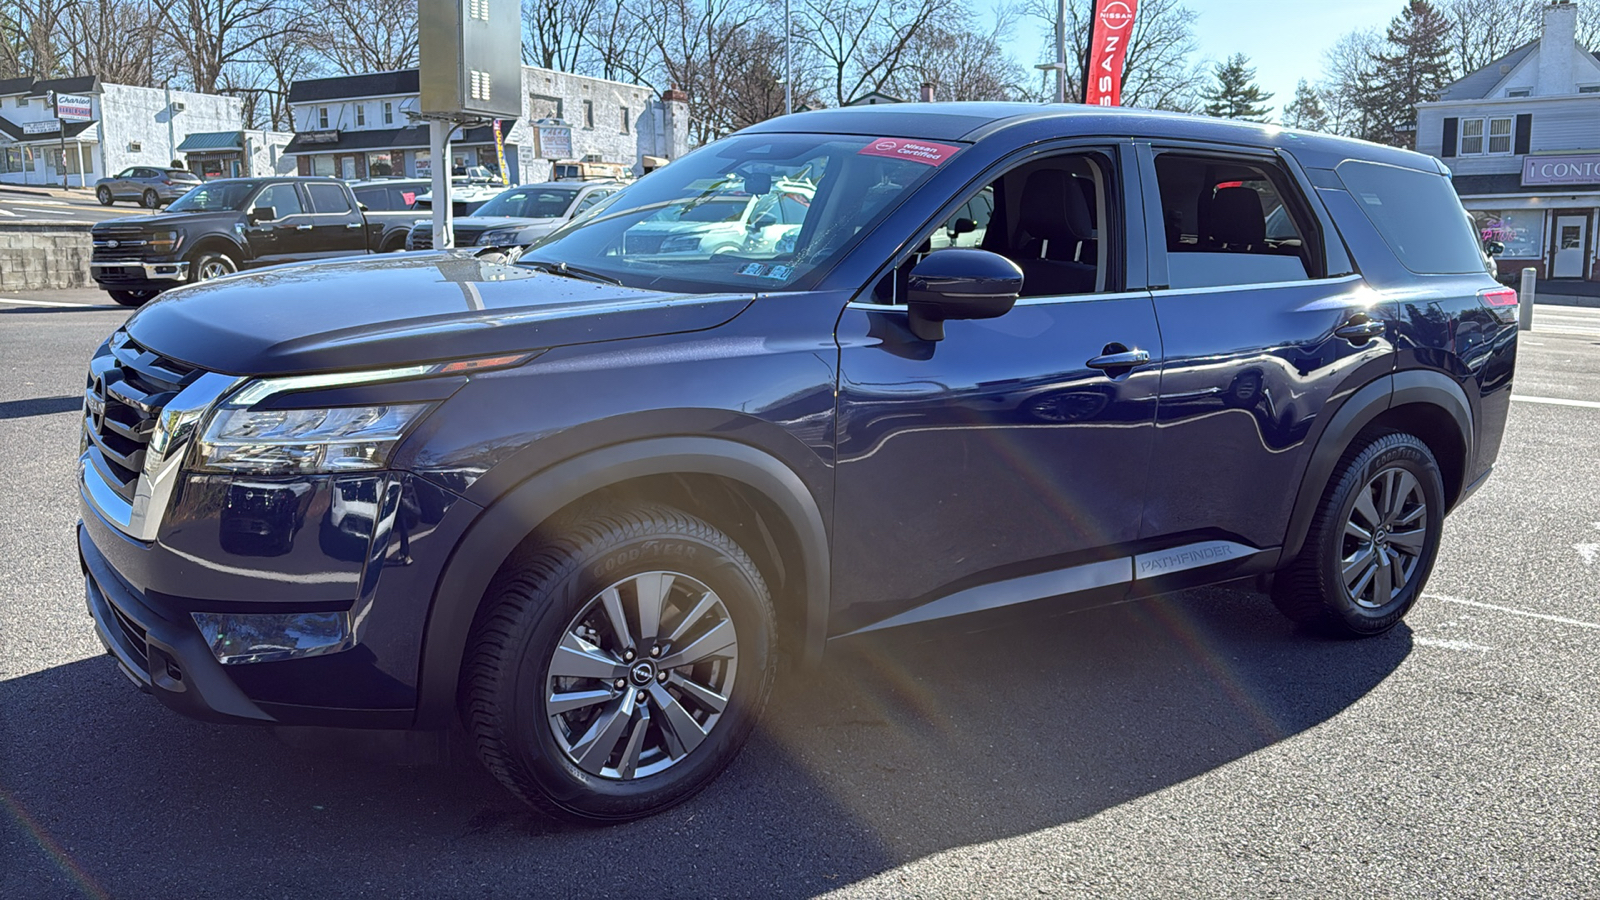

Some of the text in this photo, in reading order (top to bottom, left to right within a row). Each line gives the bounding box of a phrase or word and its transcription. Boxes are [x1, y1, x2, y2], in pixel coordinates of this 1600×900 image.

[58, 96, 90, 105] Charles
[897, 148, 942, 160] Certified
[903, 143, 938, 153] Nissan
[593, 540, 697, 579] GOODYEAR
[1141, 545, 1233, 572] PATHFINDER
